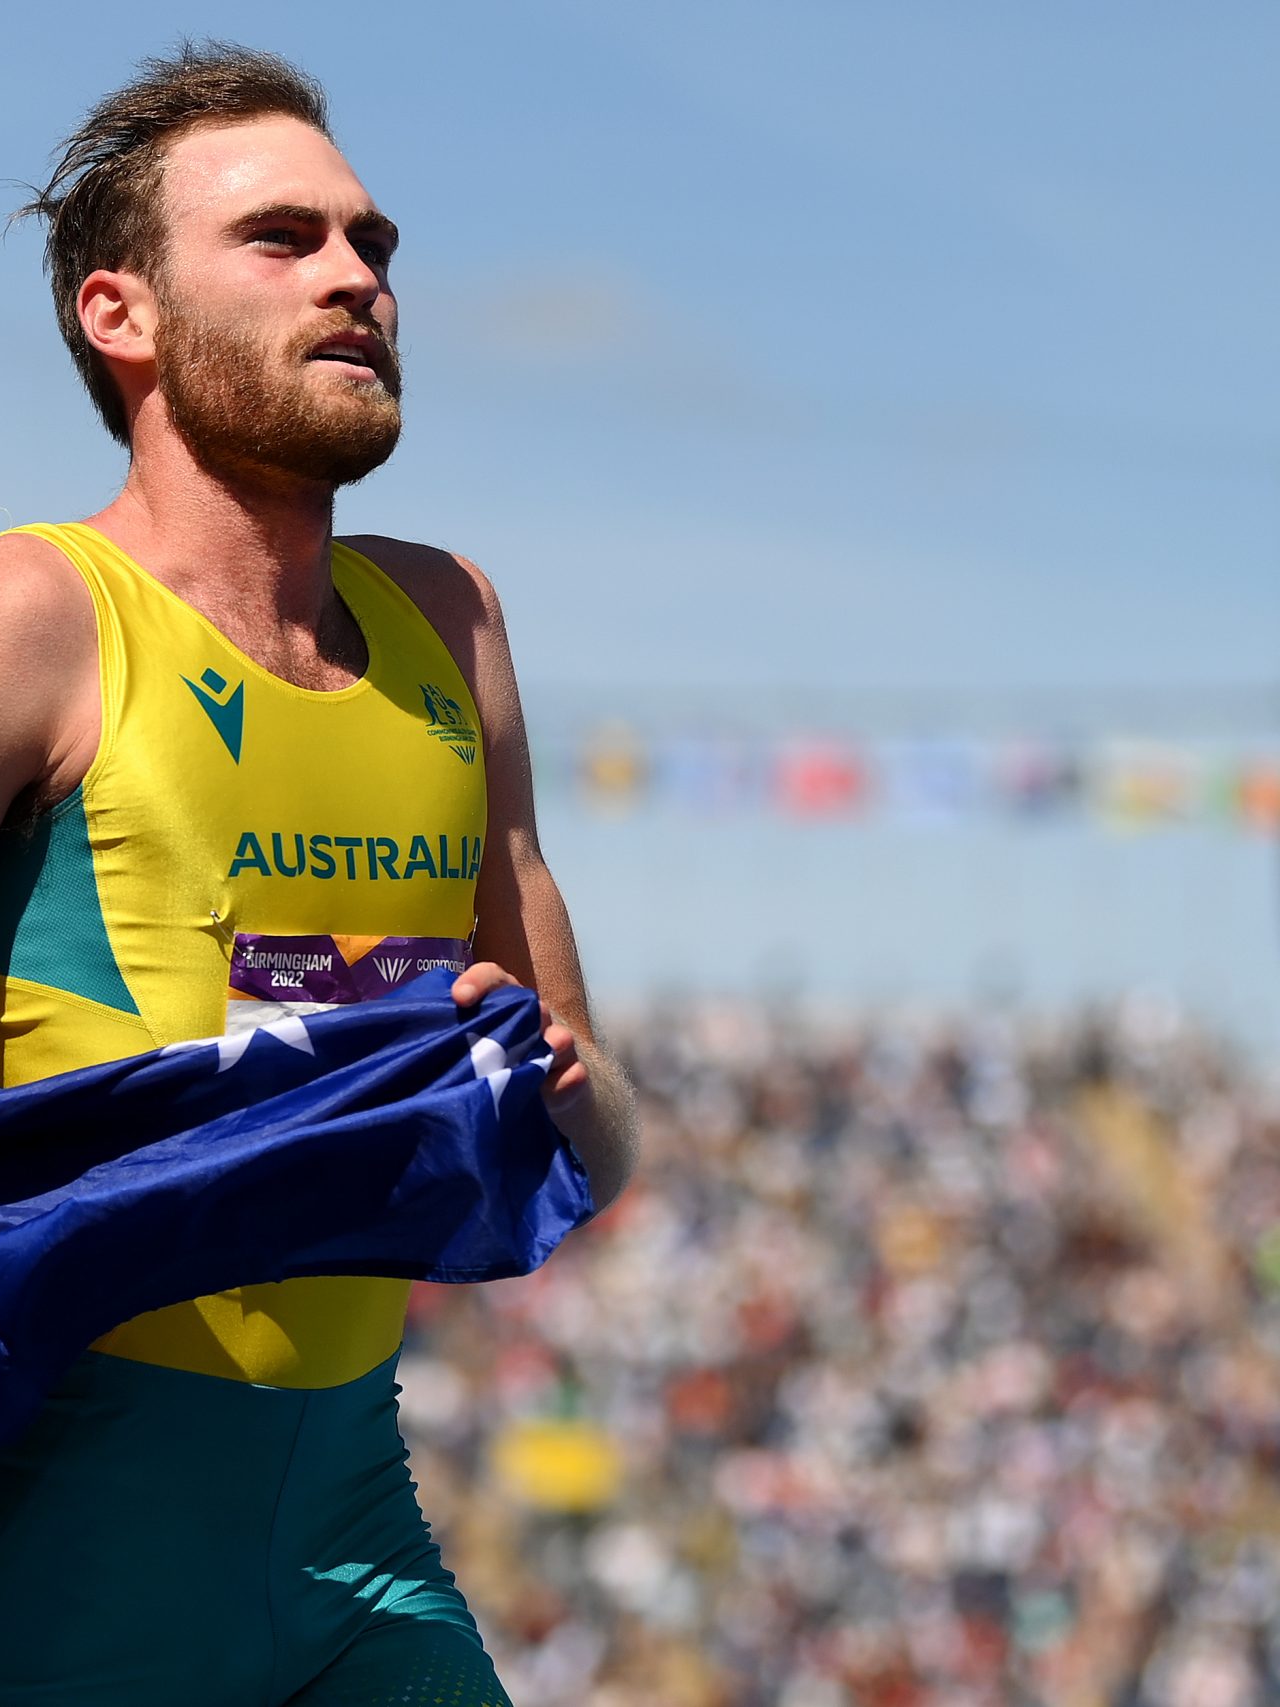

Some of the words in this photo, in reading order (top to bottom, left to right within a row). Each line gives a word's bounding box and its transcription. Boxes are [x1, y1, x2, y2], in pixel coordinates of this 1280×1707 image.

[227, 831, 482, 881] AUSTRALIA
[246, 952, 333, 972] BIRMINGHAM
[270, 969, 305, 988] 2022
